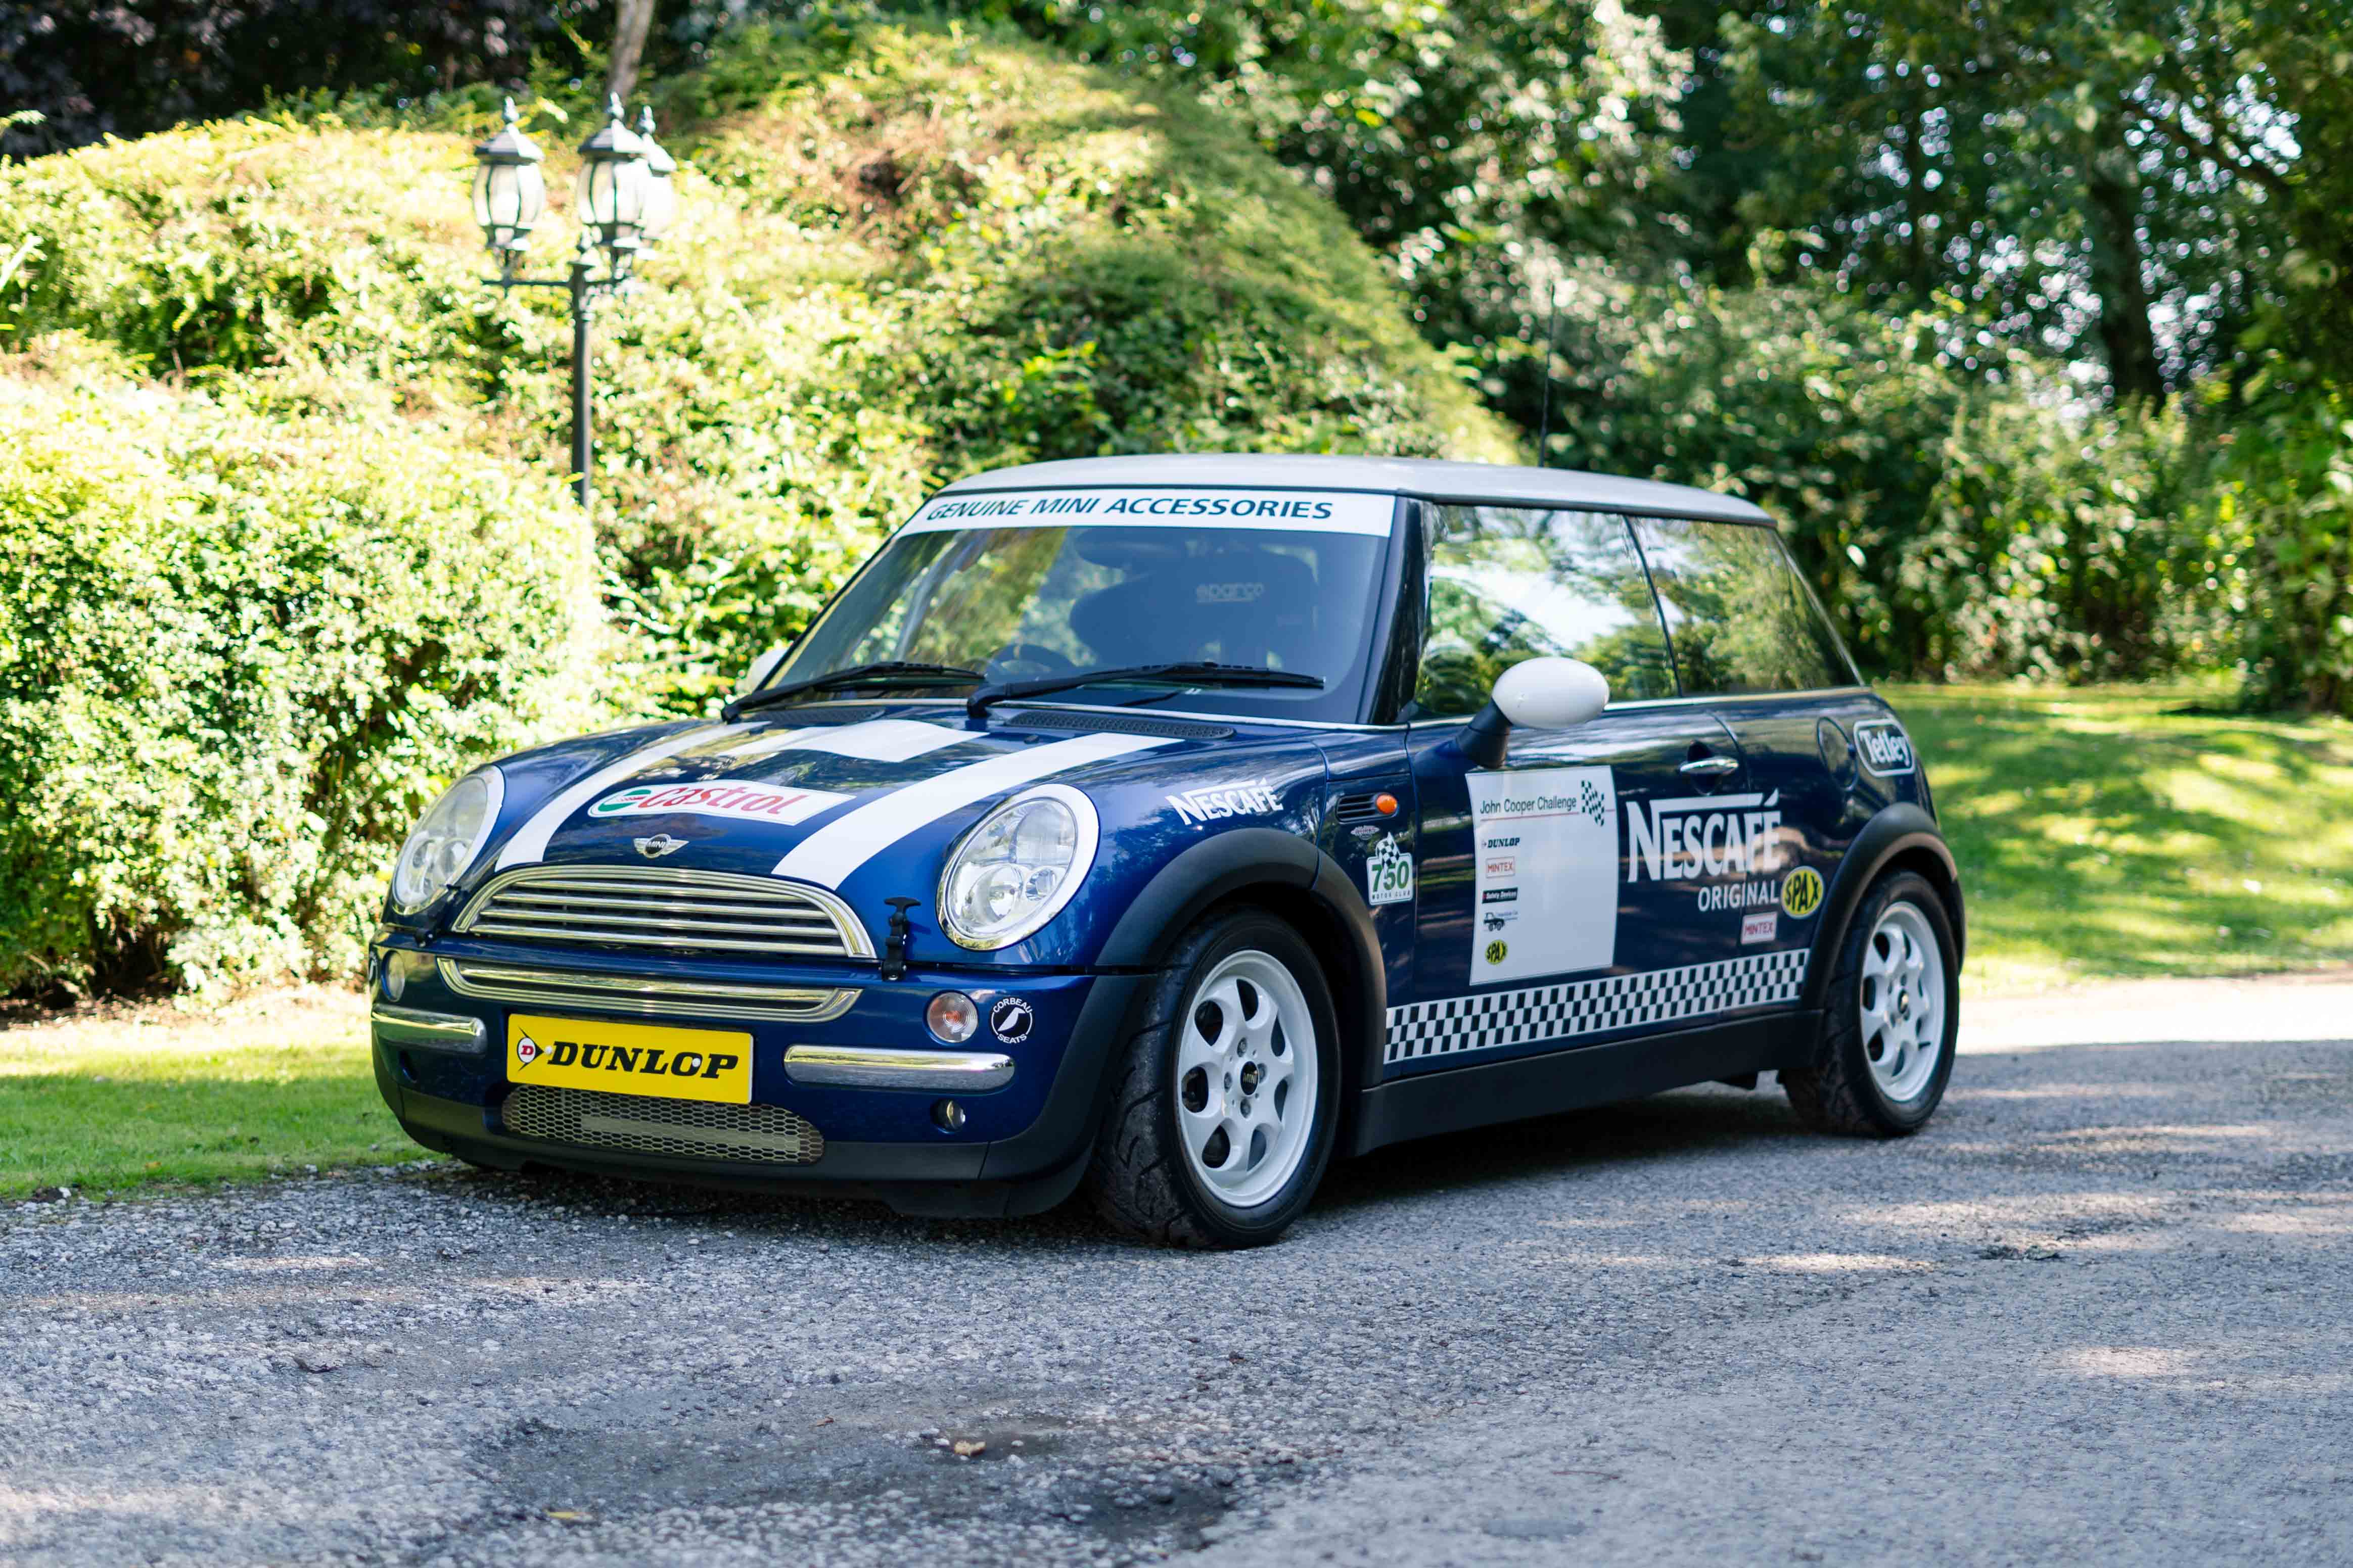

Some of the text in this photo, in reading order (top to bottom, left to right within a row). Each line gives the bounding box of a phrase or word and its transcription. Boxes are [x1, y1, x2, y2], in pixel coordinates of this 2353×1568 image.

[927, 498, 1333, 520] GENUINE MINI ACCESSORIES
[1859, 729, 1910, 767] Tetley
[637, 786, 809, 815] Castrol
[1164, 777, 1284, 825] NESCAFÉ
[1480, 796, 1577, 815] John Cooper Challenge
[647, 840, 666, 849] MINI
[1488, 837, 1520, 848] DUNLOP
[1625, 787, 1781, 883] NESCAFÉ
[1372, 861, 1409, 893] 750
[1487, 861, 1513, 873] MINTEX
[1698, 880, 1780, 912] ORIGINAL
[1784, 872, 1819, 912] SPAX
[1744, 921, 1773, 936] MINTEX
[1487, 942, 1506, 963] SPAX
[993, 997, 1033, 1013] CORBEAU
[997, 1033, 1027, 1043] SEATS
[547, 1040, 739, 1079] DUNLOP
